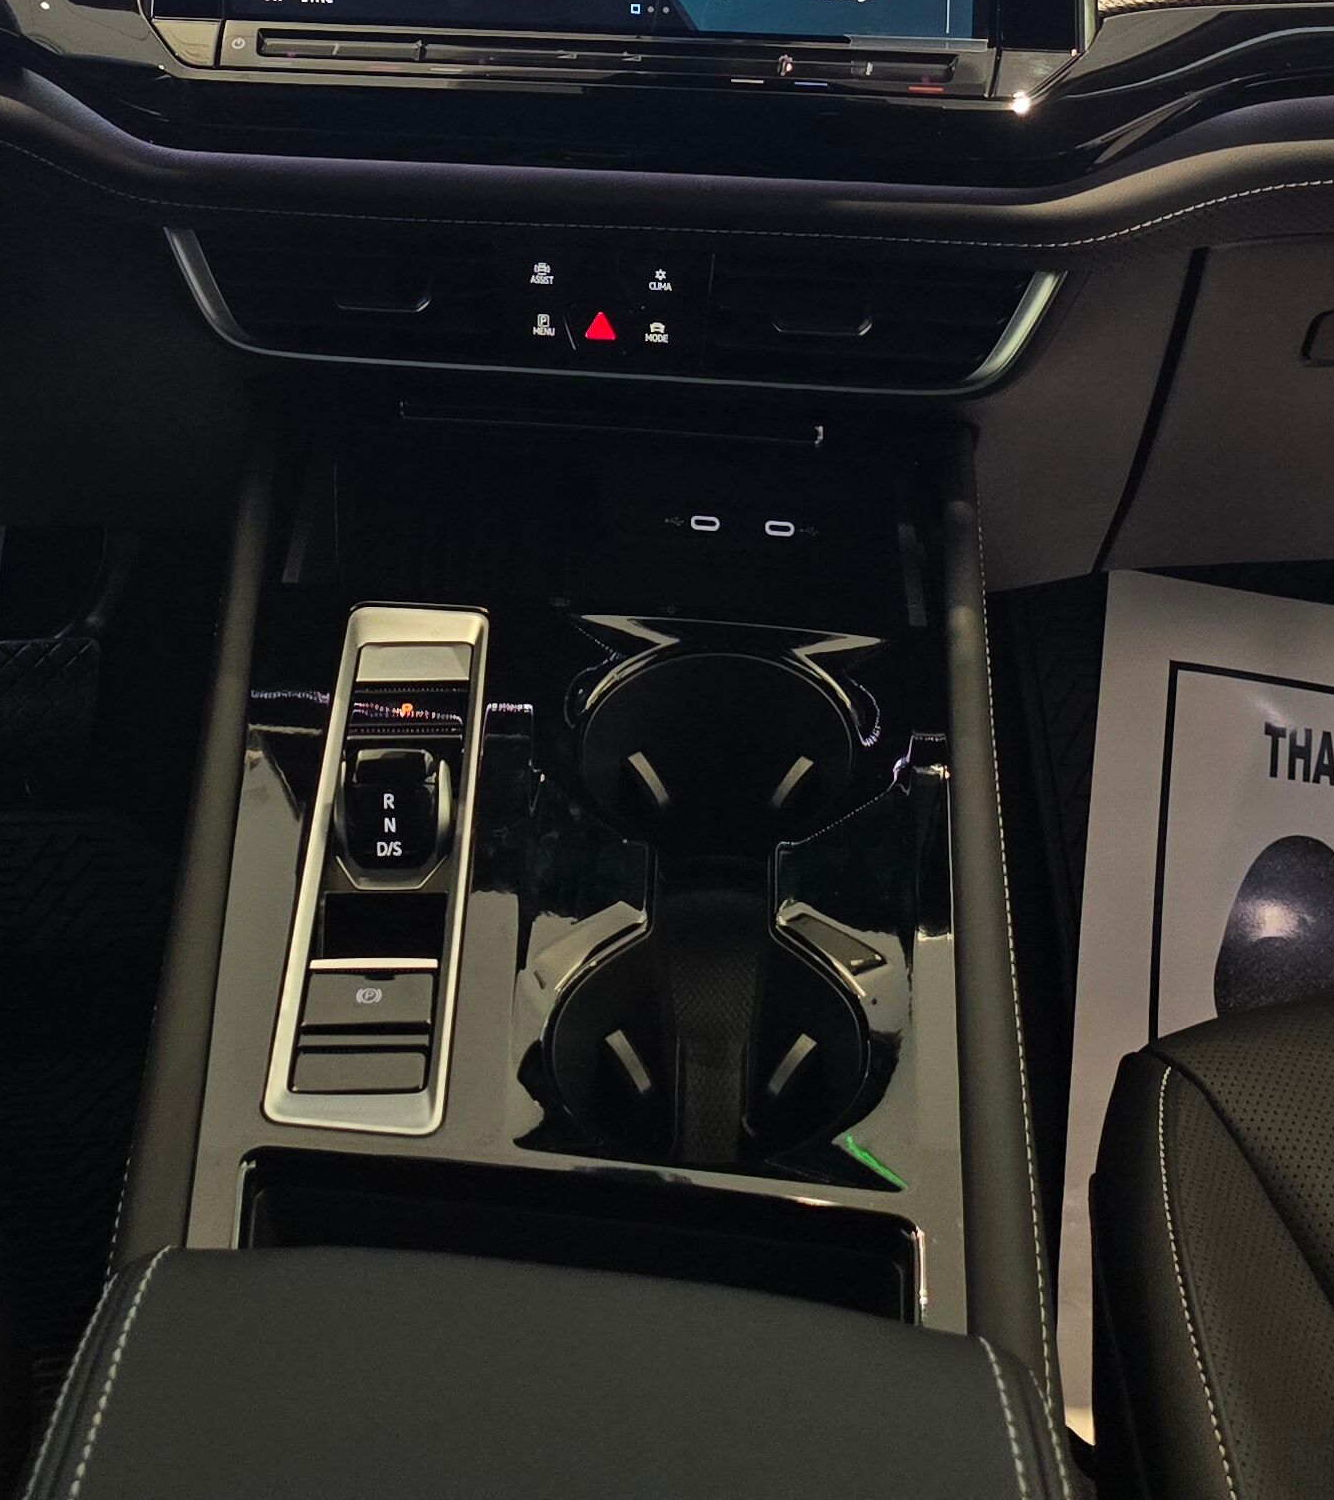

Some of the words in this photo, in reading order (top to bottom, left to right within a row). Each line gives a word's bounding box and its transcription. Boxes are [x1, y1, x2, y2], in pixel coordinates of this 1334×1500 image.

[530, 275, 554, 285] ASSIST
[648, 281, 673, 292] CLIMA
[533, 327, 556, 337] MENU
[644, 333, 668, 343] MODE
[383, 793, 395, 810] R
[384, 817, 397, 833] N
[376, 841, 403, 857] D/S
